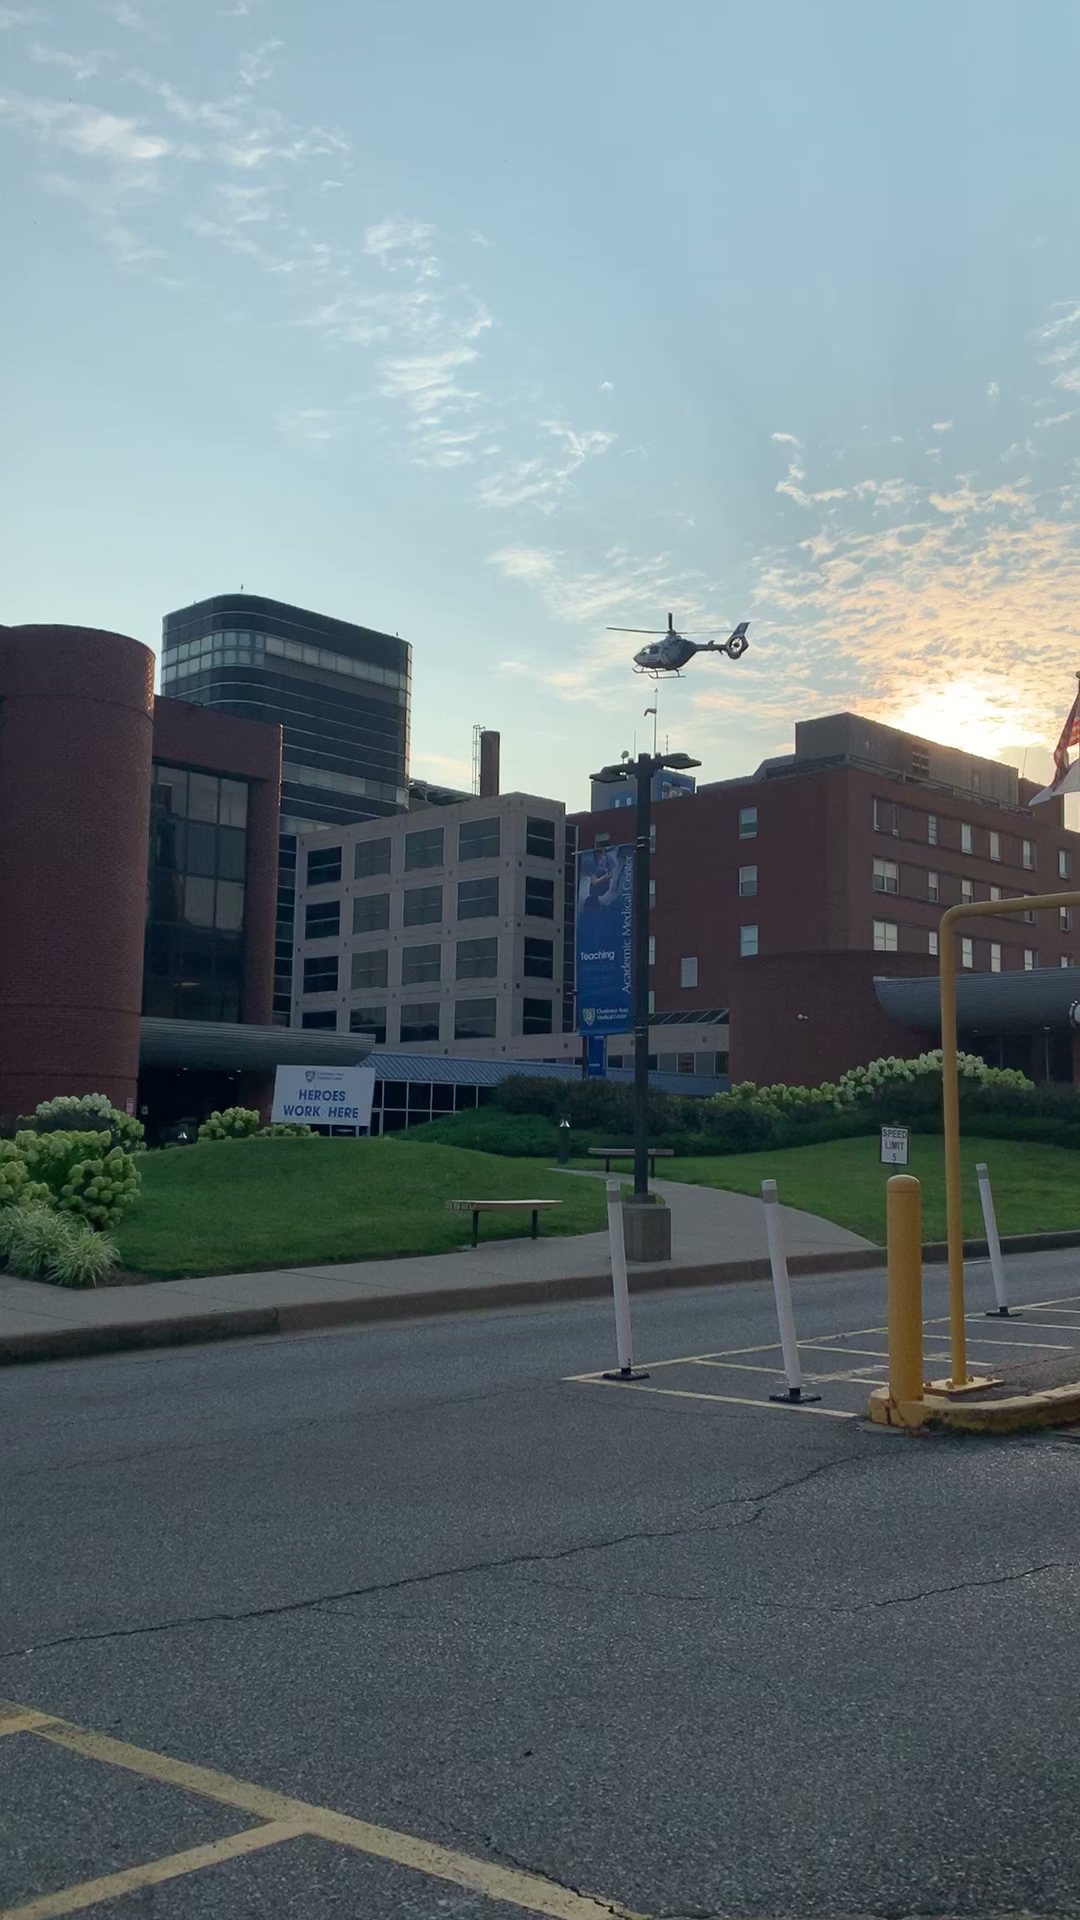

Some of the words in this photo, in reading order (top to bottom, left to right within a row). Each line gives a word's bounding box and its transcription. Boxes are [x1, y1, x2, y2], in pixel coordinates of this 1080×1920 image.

[622, 856, 632, 890] Center
[621, 893, 632, 936] Medical
[580, 950, 615, 961] Teaching
[621, 939, 632, 993] Academic
[298, 1089, 346, 1102] HEROES
[283, 1105, 321, 1117] WORK
[328, 1106, 360, 1118] HERE
[882, 1129, 907, 1139] SPEED
[884, 1140, 905, 1150] LIMIT
